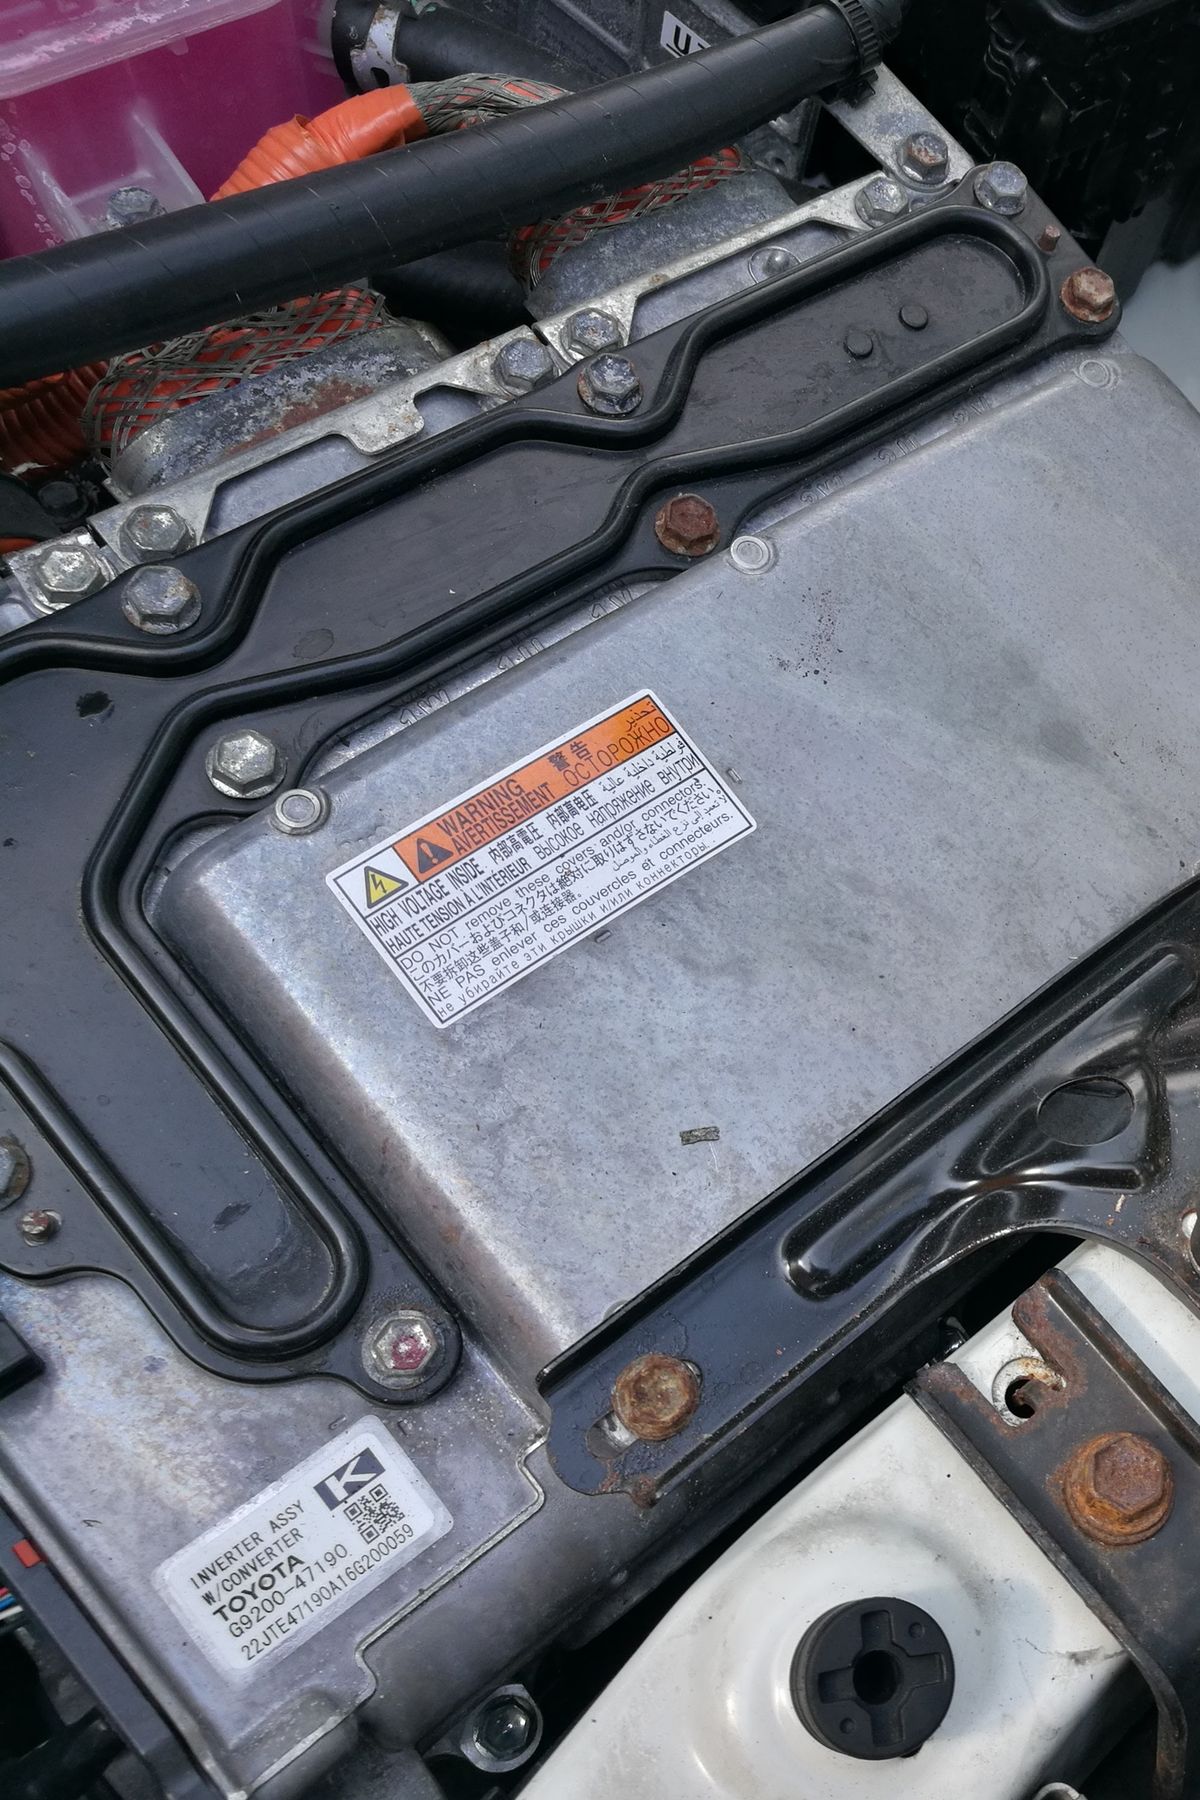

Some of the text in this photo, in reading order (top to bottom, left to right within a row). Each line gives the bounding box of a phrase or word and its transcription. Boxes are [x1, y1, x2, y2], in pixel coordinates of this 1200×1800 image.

[546, 738, 592, 772] 警告
[561, 715, 671, 788] ОСТОРОЖНО
[585, 778, 657, 829] напряжение
[656, 752, 701, 787] внутри
[435, 777, 525, 837] WARNING
[450, 781, 557, 855] AVERTISSEMENT
[485, 820, 545, 865] 内部高電圧
[369, 857, 485, 936] HIGH VOLTAGE INSIDE
[399, 776, 706, 970] DO NOT remove these covers and/or connectors.
[426, 810, 733, 1006] NE PAS enlever ces couvercles et connecteurs.
[384, 922, 424, 953] HAUTE
[418, 896, 467, 932] TENSION
[436, 1001, 455, 1017] не
[456, 958, 523, 1005] убирайте
[522, 941, 547, 962] эти
[548, 909, 598, 945] крышки
[598, 887, 634, 914] и/или
[189, 1498, 306, 1590] INVERTER ASSY
[200, 1526, 304, 1606] W/CONVERTER
[211, 1552, 305, 1623] TOYOTA
[226, 1542, 351, 1639] G9200-47190
[238, 1522, 416, 1661] 22JTE47190A16G200059
